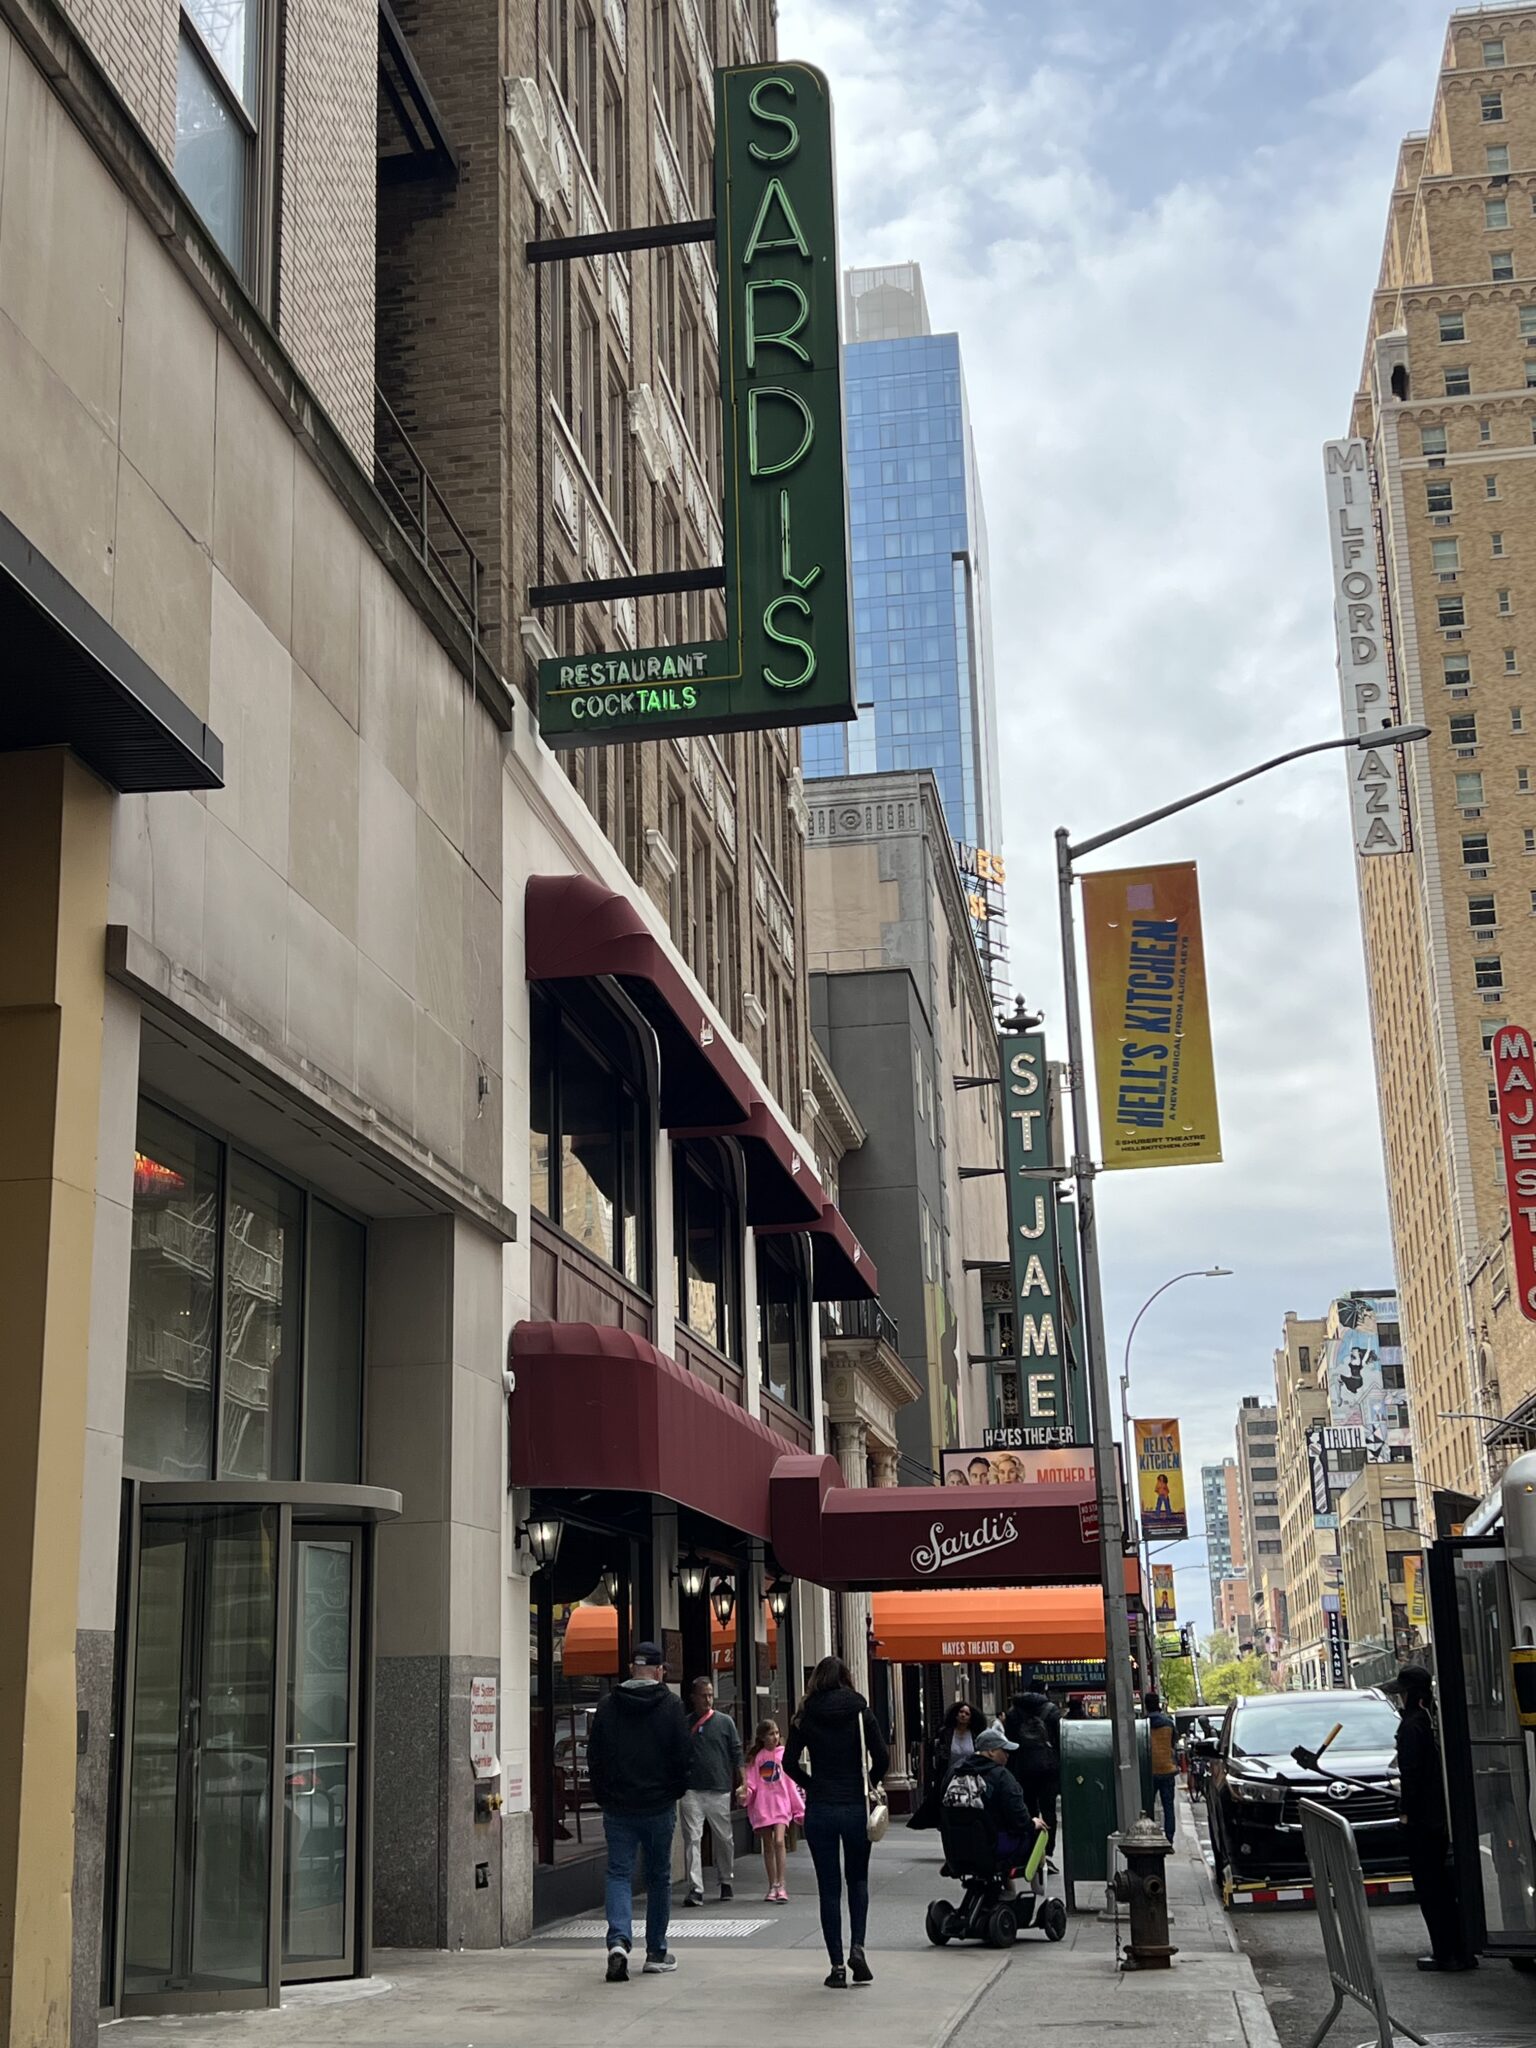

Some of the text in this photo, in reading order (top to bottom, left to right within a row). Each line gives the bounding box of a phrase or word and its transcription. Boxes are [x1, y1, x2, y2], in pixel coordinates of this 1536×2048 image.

[743, 76, 824, 691] SARDI'S
[1327, 443, 1378, 666] MILFORD
[560, 652, 707, 689] RESTAURANT
[570, 686, 697, 719] COCKTAILS
[1116, 919, 1179, 1128] HELL'S KITCHEN
[1171, 1038, 1181, 1085] MUSICAL
[1010, 1052, 1041, 1152] ST
[1170, 1087, 1178, 1111] NEW
[1169, 1113, 1176, 1121] A
[1121, 1134, 1206, 1146] SHUBERT THEATRE
[1143, 1436, 1173, 1453] HELL'S
[1326, 1428, 1362, 1448] TRUTH
[1139, 1453, 1180, 1470] KITCHEN
[910, 1512, 1019, 1574] Sardi's
[941, 1641, 966, 1656] HAYES
[967, 1640, 1000, 1655] THEATER
